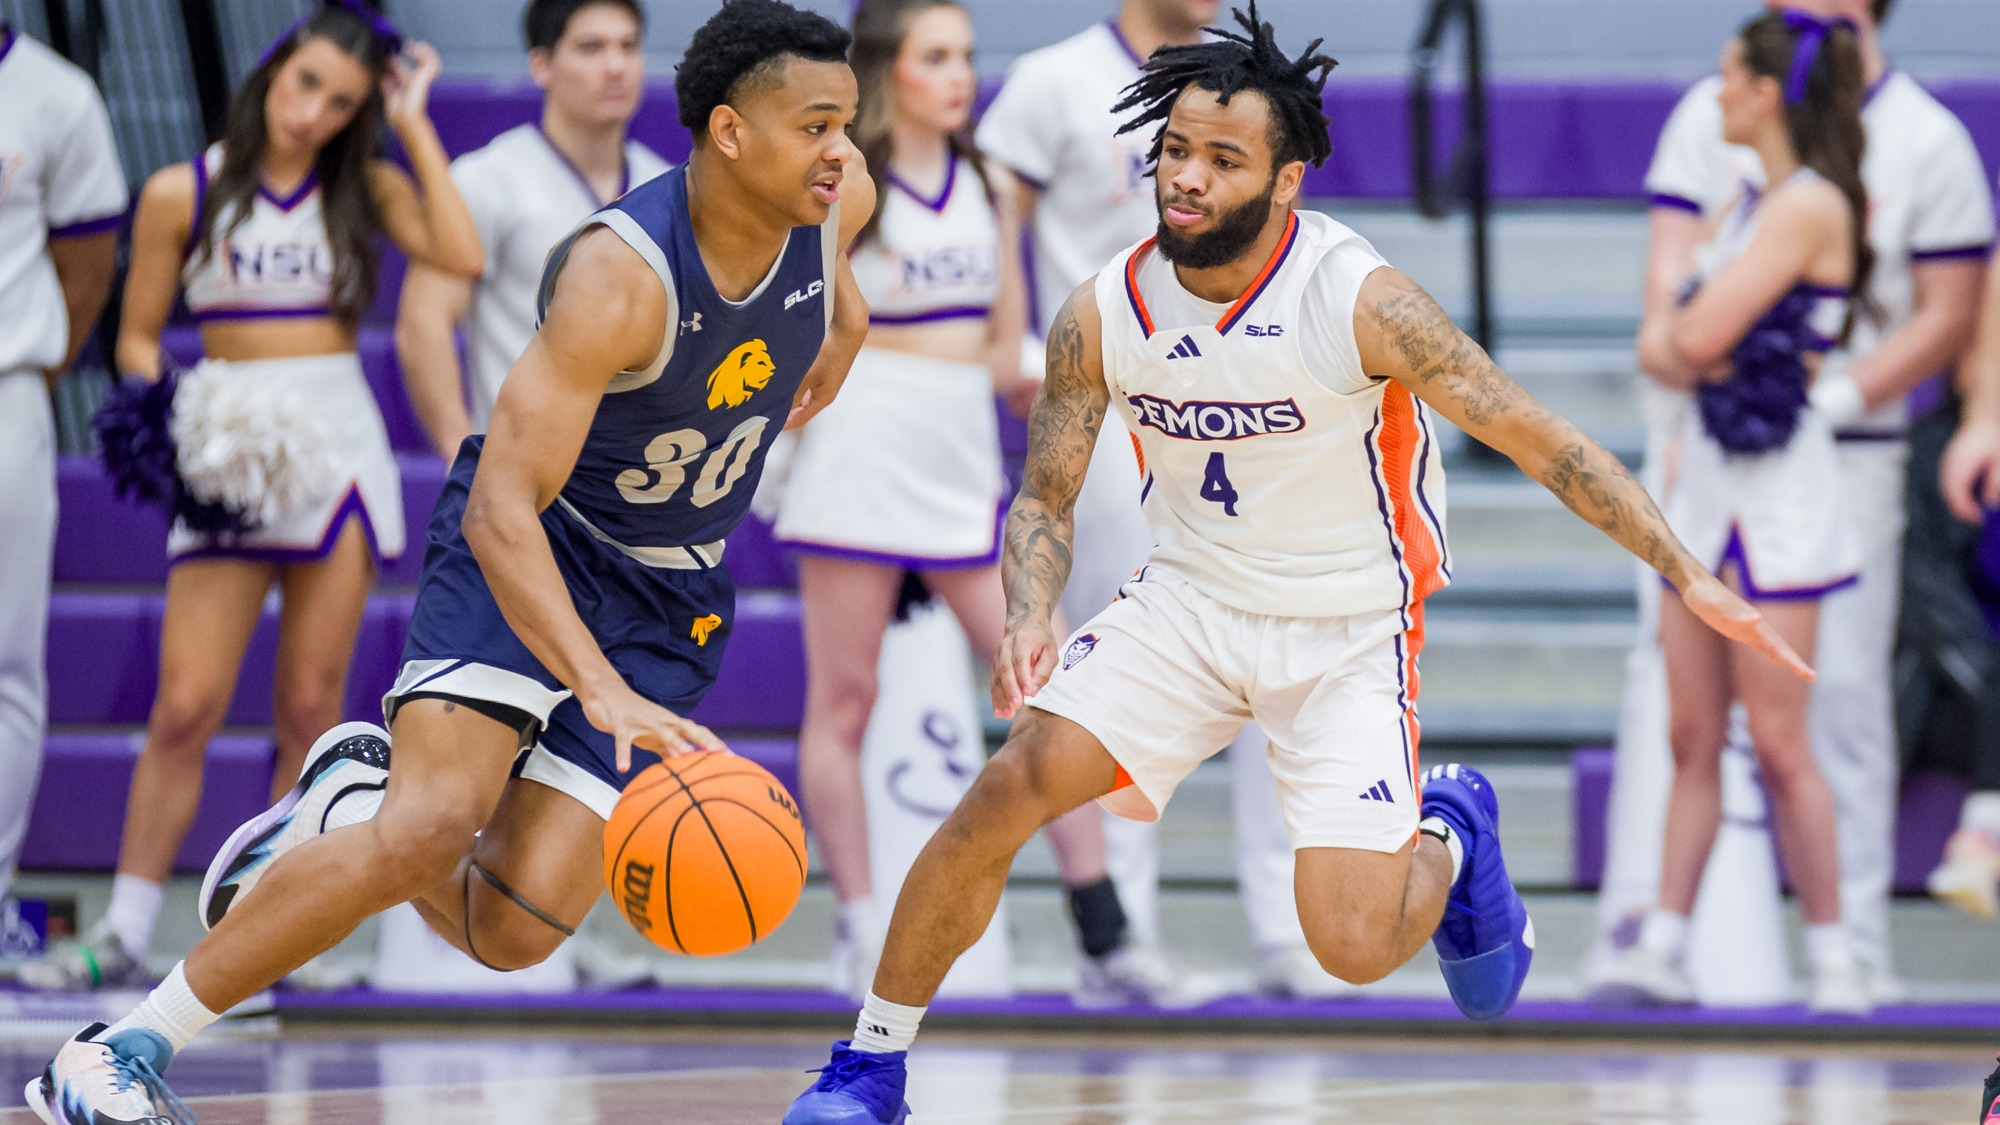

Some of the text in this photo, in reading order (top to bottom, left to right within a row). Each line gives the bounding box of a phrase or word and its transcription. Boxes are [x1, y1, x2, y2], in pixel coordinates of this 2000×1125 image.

[784, 279, 824, 311] SLC
[1245, 324, 1284, 337] SLC
[614, 415, 770, 508] 30
[1200, 452, 1238, 516] 4
